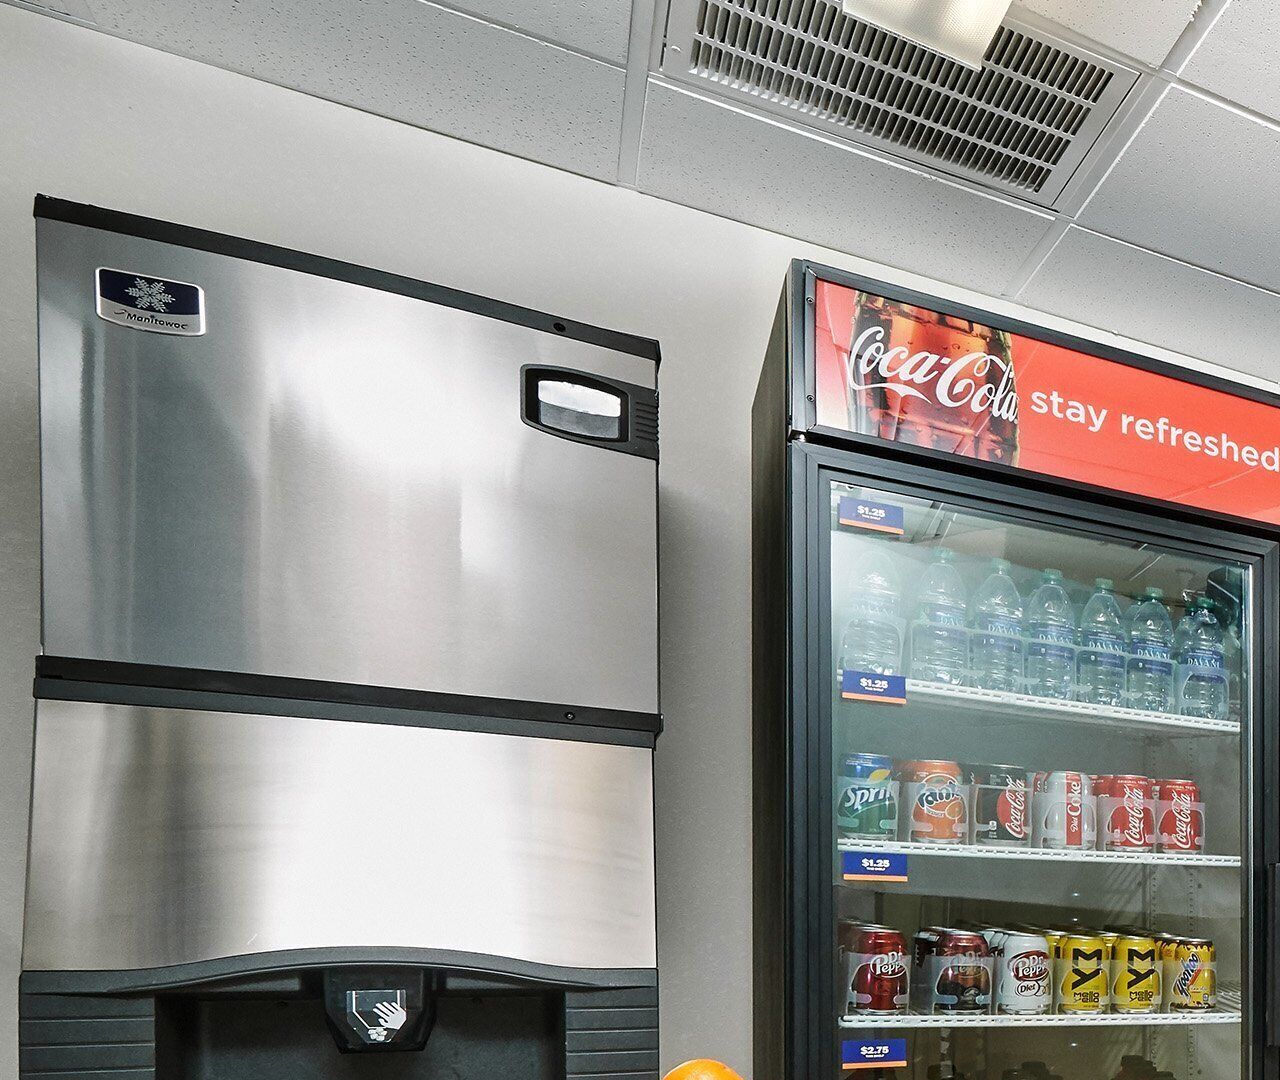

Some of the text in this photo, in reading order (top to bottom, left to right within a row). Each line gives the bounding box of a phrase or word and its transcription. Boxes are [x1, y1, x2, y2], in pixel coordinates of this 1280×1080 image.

[126, 312, 188, 329] Manitowoc
[1031, 389, 1280, 474] stay refreshed
[857, 506, 885, 518] $1.25
[860, 677, 888, 689] $1.25
[1068, 781, 1081, 817] Coke
[861, 858, 890, 868] $1.25
[861, 1046, 889, 1055] $2.75
